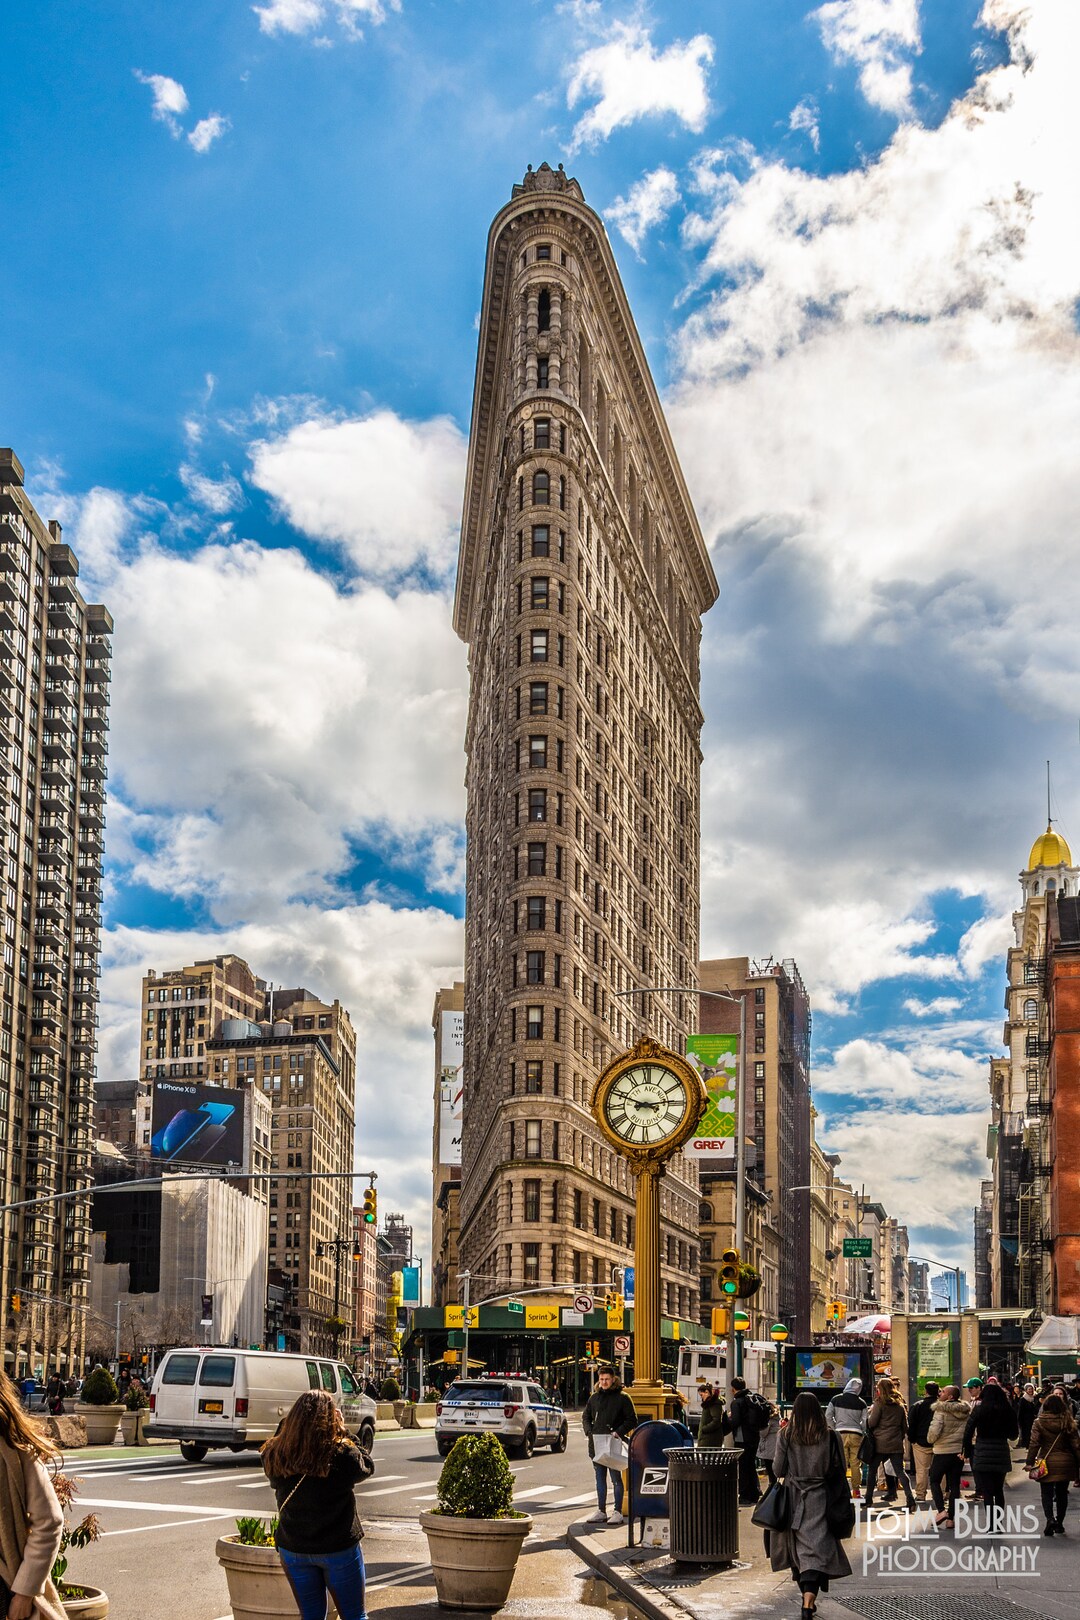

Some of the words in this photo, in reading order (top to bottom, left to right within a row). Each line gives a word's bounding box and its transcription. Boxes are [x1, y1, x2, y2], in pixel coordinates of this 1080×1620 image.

[162, 1083, 185, 1092] iPhone
[630, 1113, 663, 1126] BUILDING
[693, 1141, 726, 1149] GREY
[528, 1313, 548, 1322] Sprint
